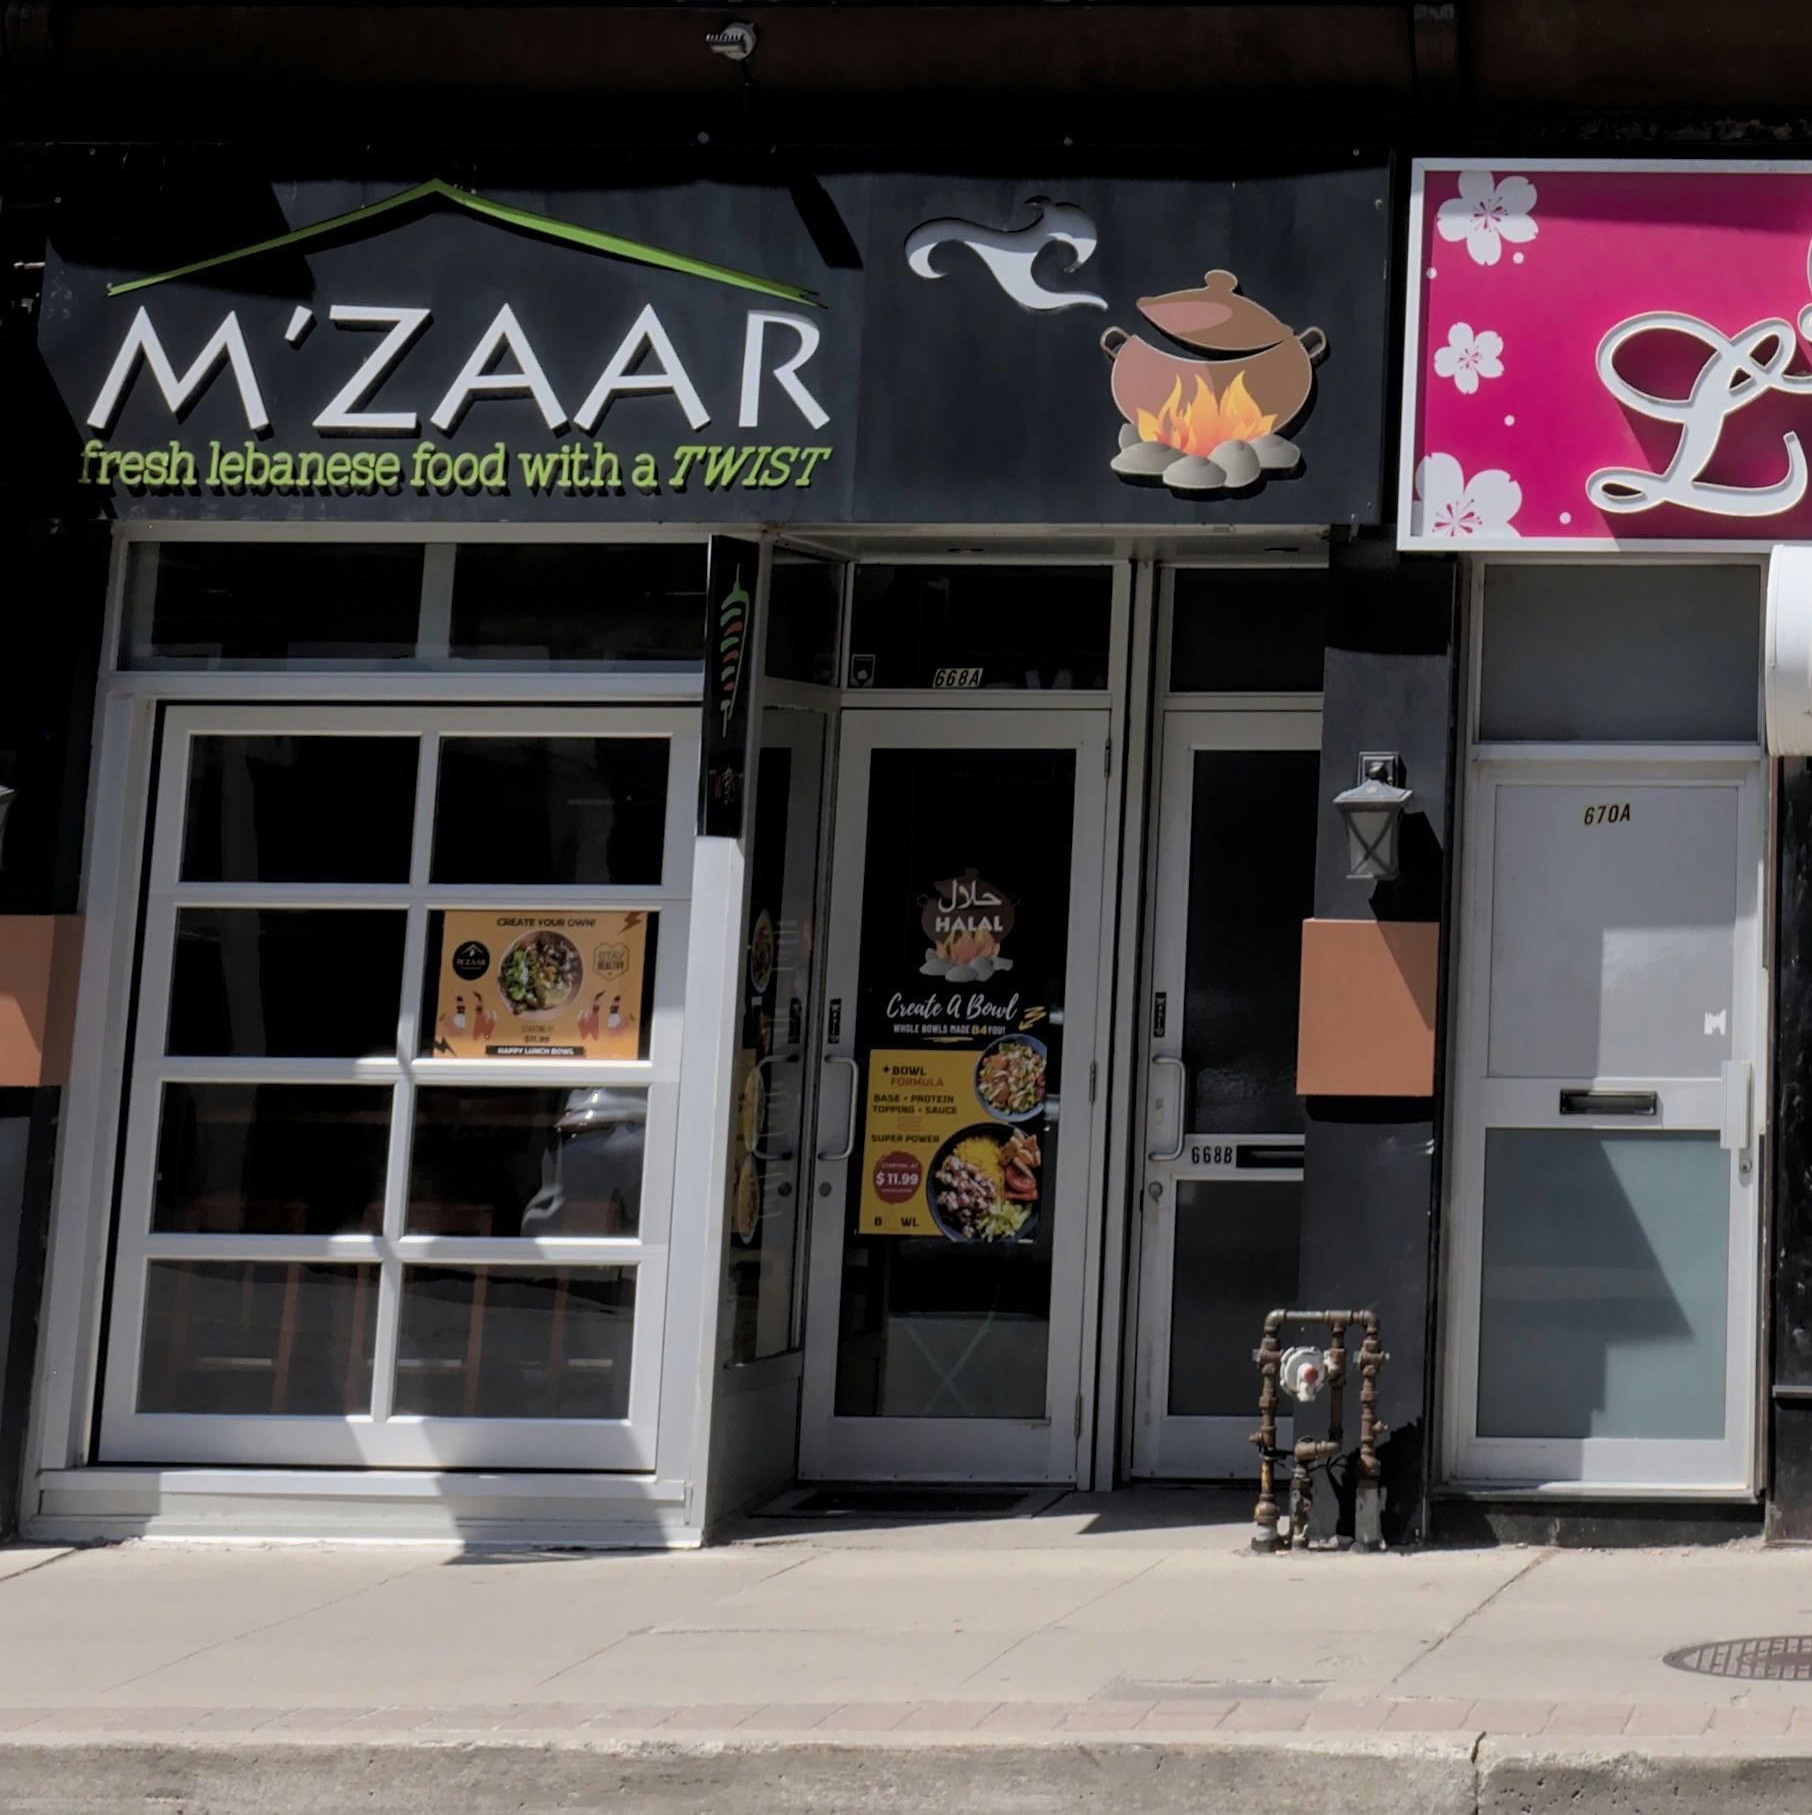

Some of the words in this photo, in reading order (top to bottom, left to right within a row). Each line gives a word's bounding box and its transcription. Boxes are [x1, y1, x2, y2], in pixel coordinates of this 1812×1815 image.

[86, 302, 831, 432] M'ZAAR
[79, 441, 196, 487] fresh
[207, 441, 400, 488] lebanese
[410, 441, 506, 488] food
[519, 442, 622, 487] with
[632, 455, 658, 487] a
[667, 445, 831, 488] TWIST
[933, 667, 983, 689] 668A
[1584, 803, 1630, 826] 670A
[937, 879, 1002, 913] حلال
[496, 917, 535, 927] CREATE
[536, 918, 566, 927] YOUR
[935, 915, 1004, 933] HALAL
[886, 992, 944, 1020] Create
[947, 993, 963, 1019] A
[966, 992, 1020, 1022] Bowl
[893, 1023, 920, 1034] WHOLE
[921, 1024, 948, 1035] BOWLS
[950, 1024, 970, 1035] MADE
[497, 1047, 523, 1055] HAPPY
[524, 1047, 550, 1055] LUNCH
[892, 1065, 928, 1076] BOWL
[890, 1077, 945, 1087] FORMULA
[874, 1094, 900, 1103] BASE
[910, 1094, 955, 1103] PROTEIN
[873, 1105, 915, 1114] TOPPING
[925, 1106, 958, 1115] SAUCE
[871, 1134, 903, 1143] SUPER
[905, 1134, 940, 1143] POWER
[1191, 1145, 1233, 1164] 668B
